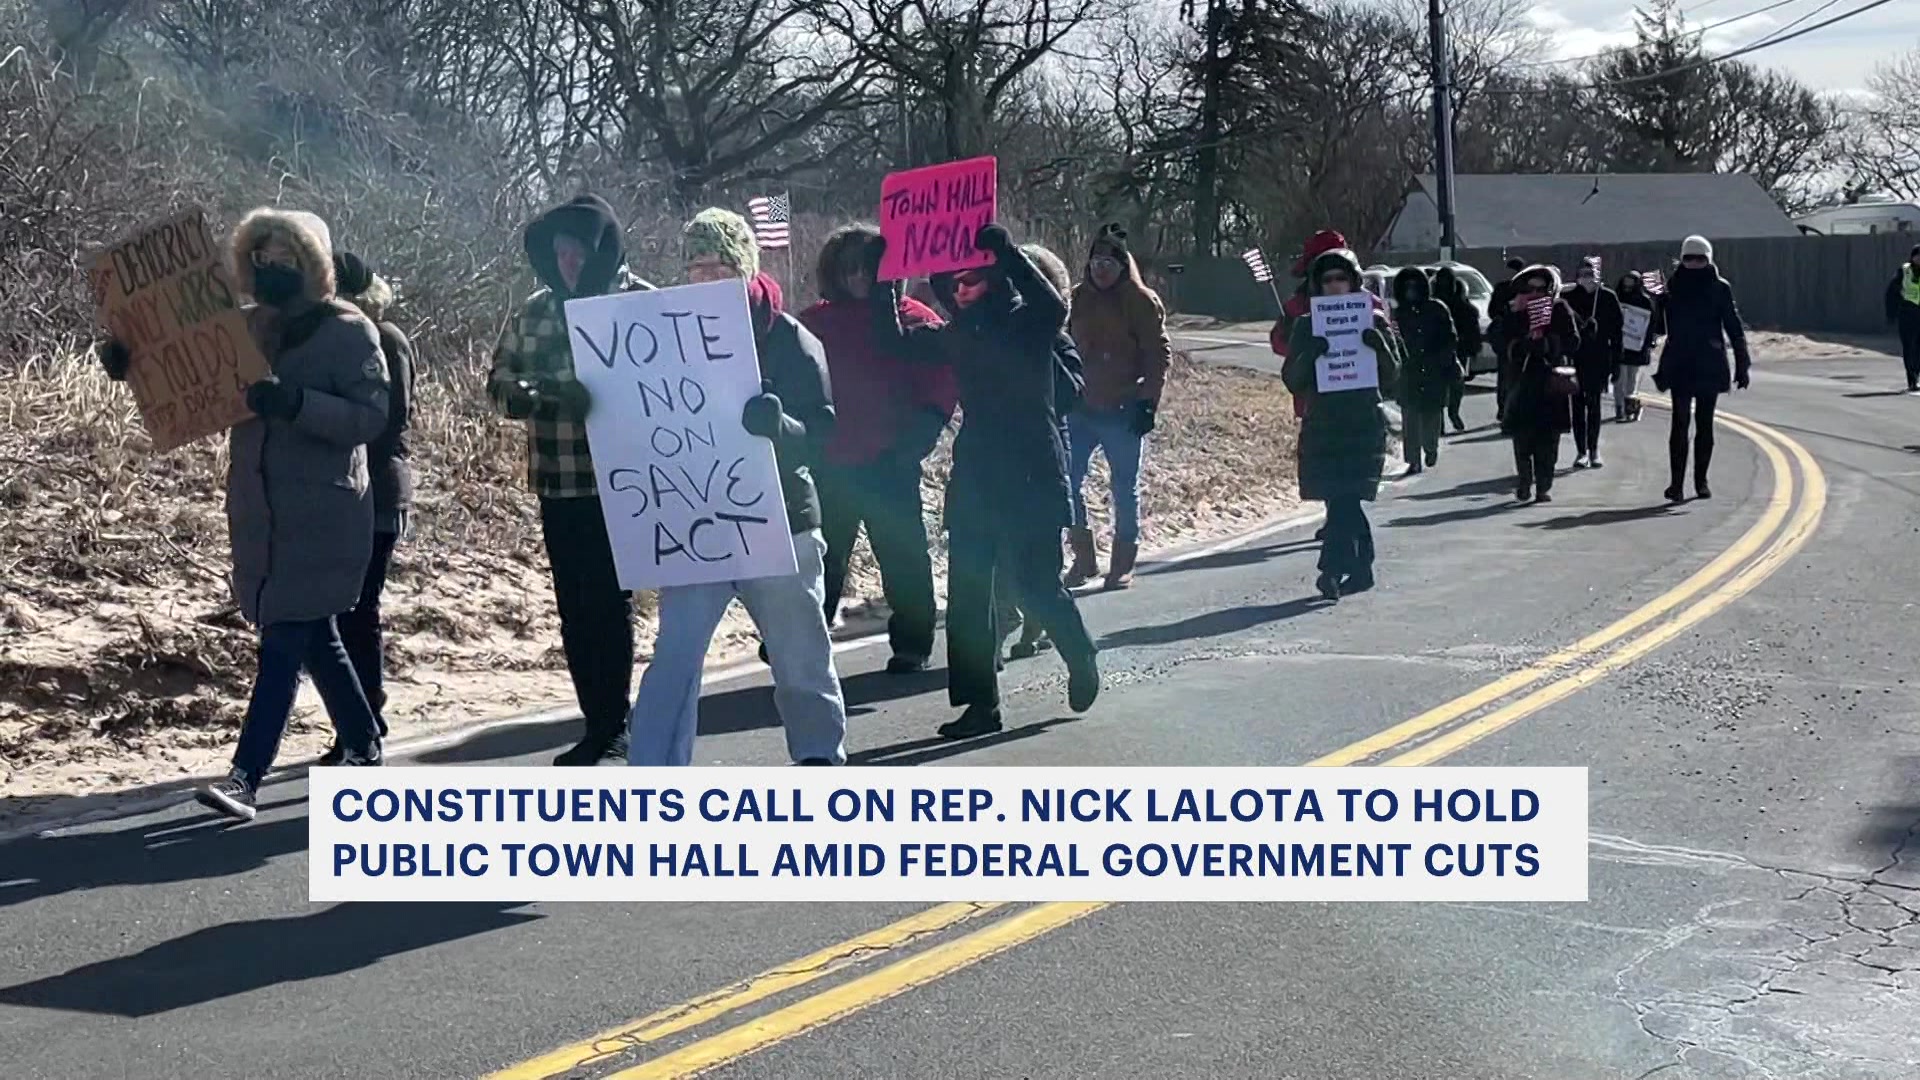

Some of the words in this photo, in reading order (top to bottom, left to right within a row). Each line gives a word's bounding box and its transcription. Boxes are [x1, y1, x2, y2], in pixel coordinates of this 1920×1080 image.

[882, 179, 938, 220] TOWN
[946, 172, 994, 213] HALL
[110, 212, 212, 296] DEMOCRACY
[163, 262, 235, 328] WORKS
[151, 338, 202, 397] YOU
[194, 322, 239, 378] DO
[574, 311, 734, 369] VOTE
[637, 376, 706, 418] NO
[650, 421, 716, 458] ON
[608, 456, 765, 518] SAVE
[654, 511, 769, 566] ACT
